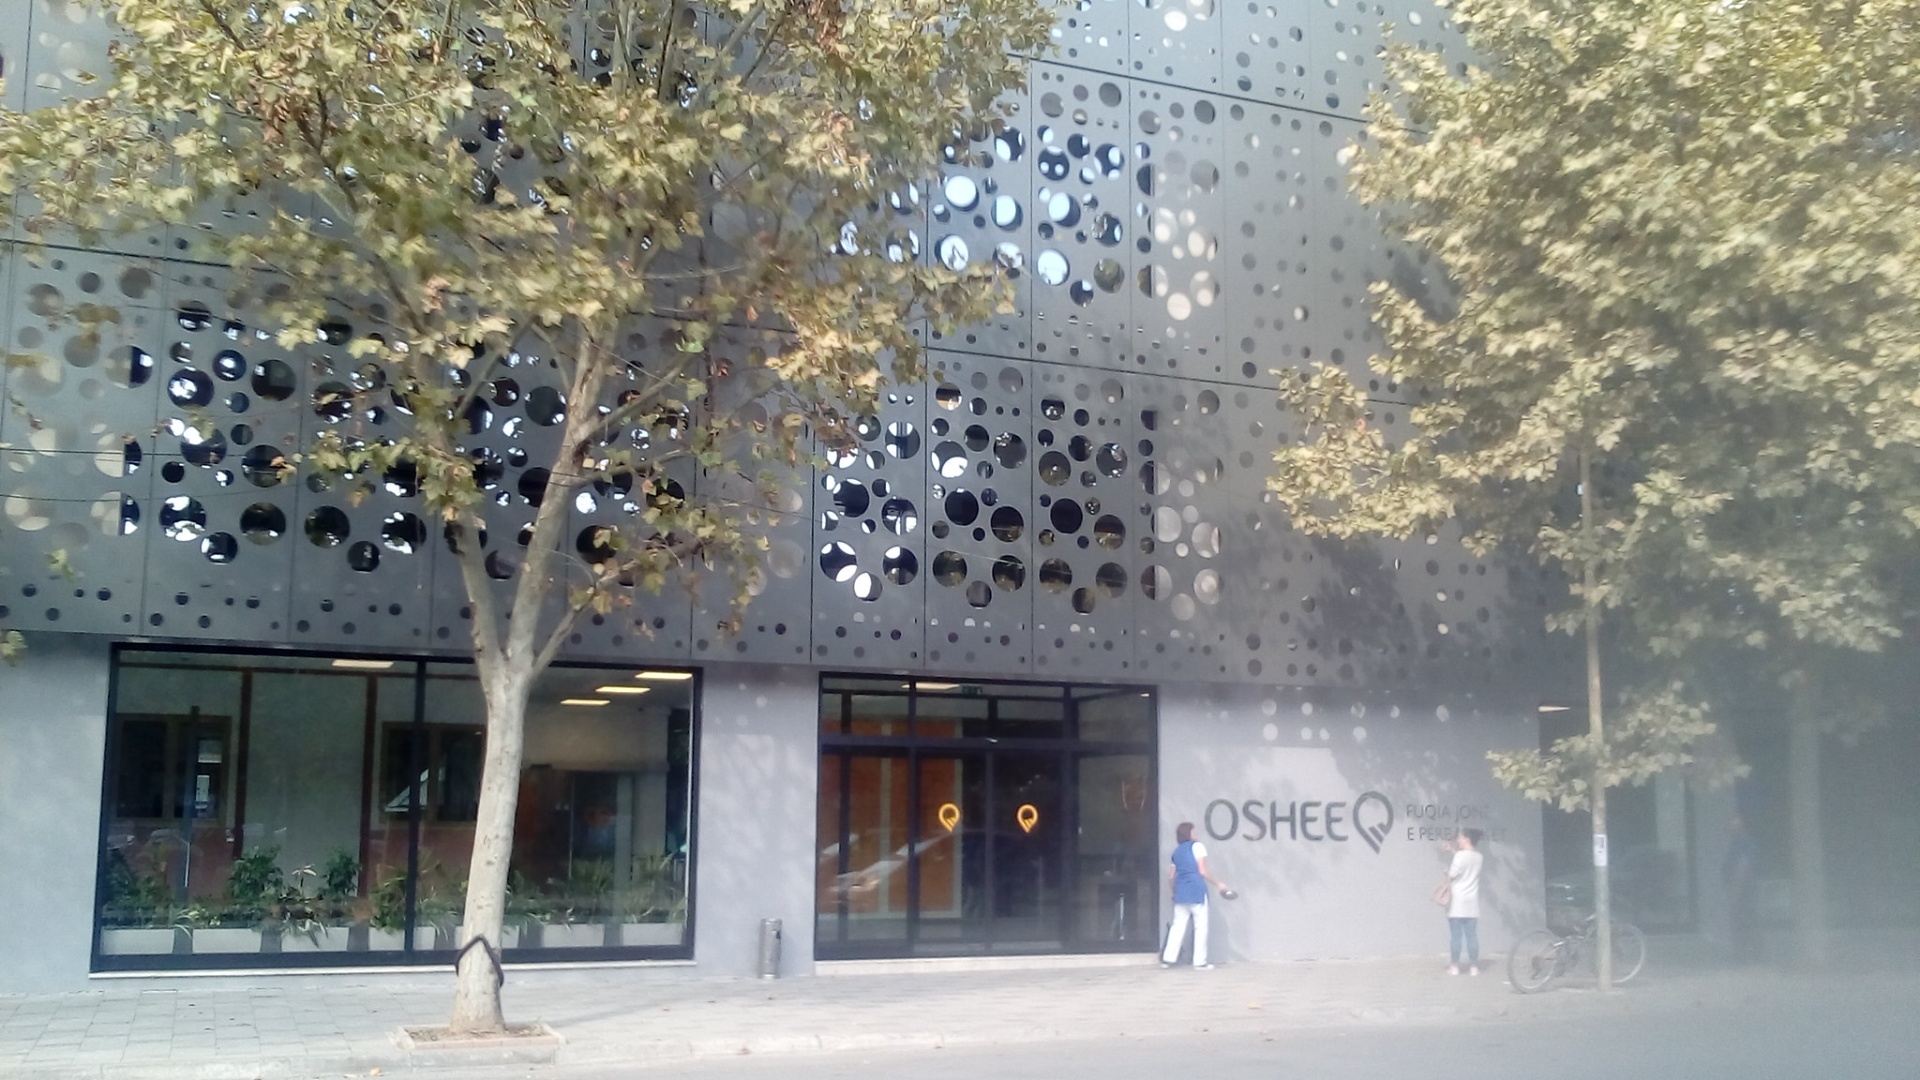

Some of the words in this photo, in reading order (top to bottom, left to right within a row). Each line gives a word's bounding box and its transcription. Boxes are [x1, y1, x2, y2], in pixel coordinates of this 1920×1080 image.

[1204, 798, 1349, 842] OSHEE
[1406, 804, 1451, 820] FUQIA
[1407, 827, 1415, 841] E
